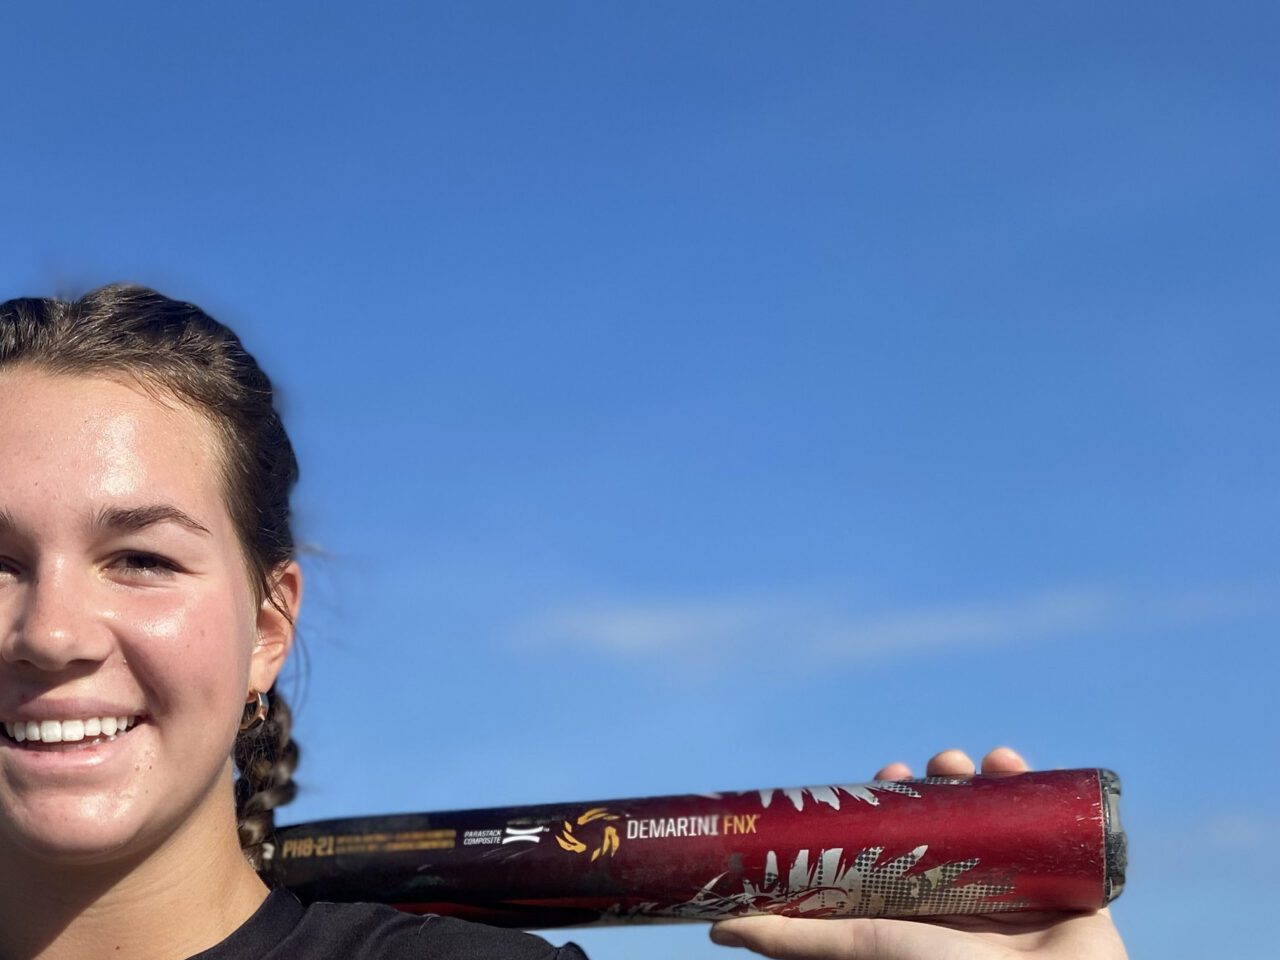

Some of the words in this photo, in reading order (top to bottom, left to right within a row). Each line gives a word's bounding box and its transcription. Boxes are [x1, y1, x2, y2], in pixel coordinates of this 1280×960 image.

[627, 814, 718, 839] DEMARINI
[723, 814, 757, 835] FNX
[463, 836, 501, 845] COMPOSITE
